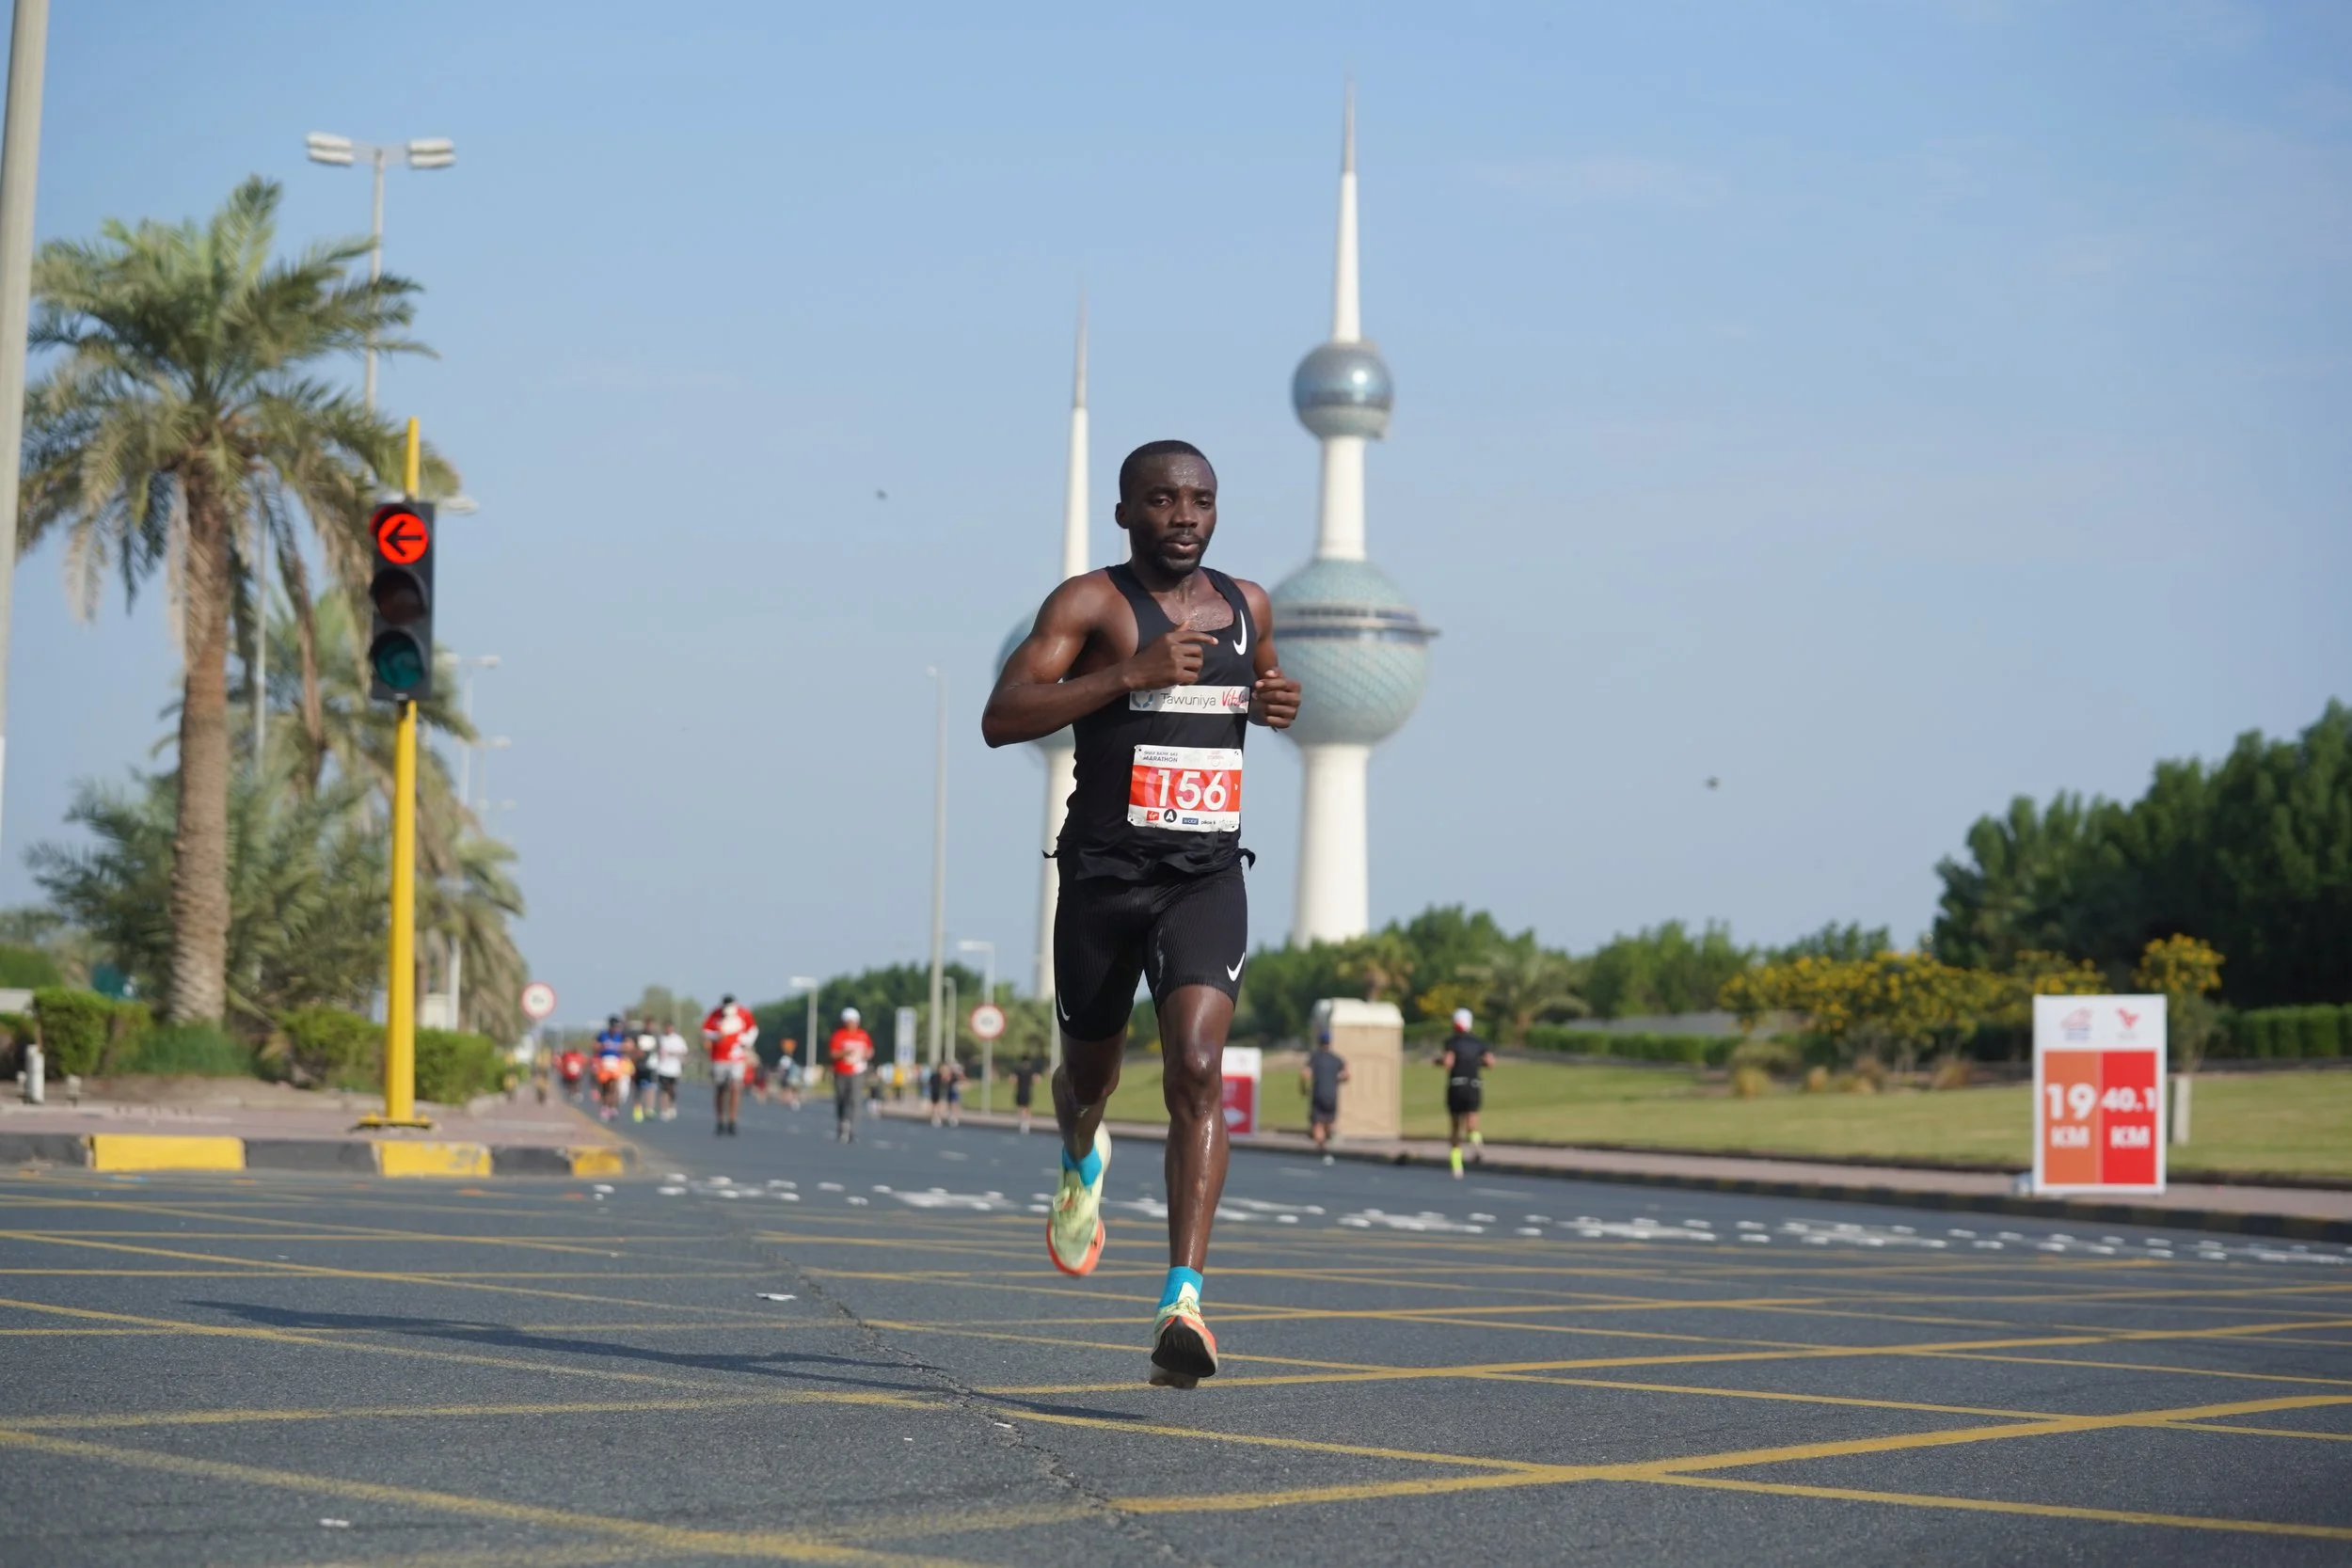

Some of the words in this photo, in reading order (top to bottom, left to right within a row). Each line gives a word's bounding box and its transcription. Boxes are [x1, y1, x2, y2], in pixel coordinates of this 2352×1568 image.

[1161, 692, 1216, 709] Tawuniya
[1157, 770, 1227, 811] 156
[1166, 811, 1174, 821] A
[2046, 1083, 2096, 1120] 19
[2101, 1085, 2158, 1113] 40.1
[2051, 1125, 2090, 1149] KM
[2110, 1125, 2152, 1149] KM
